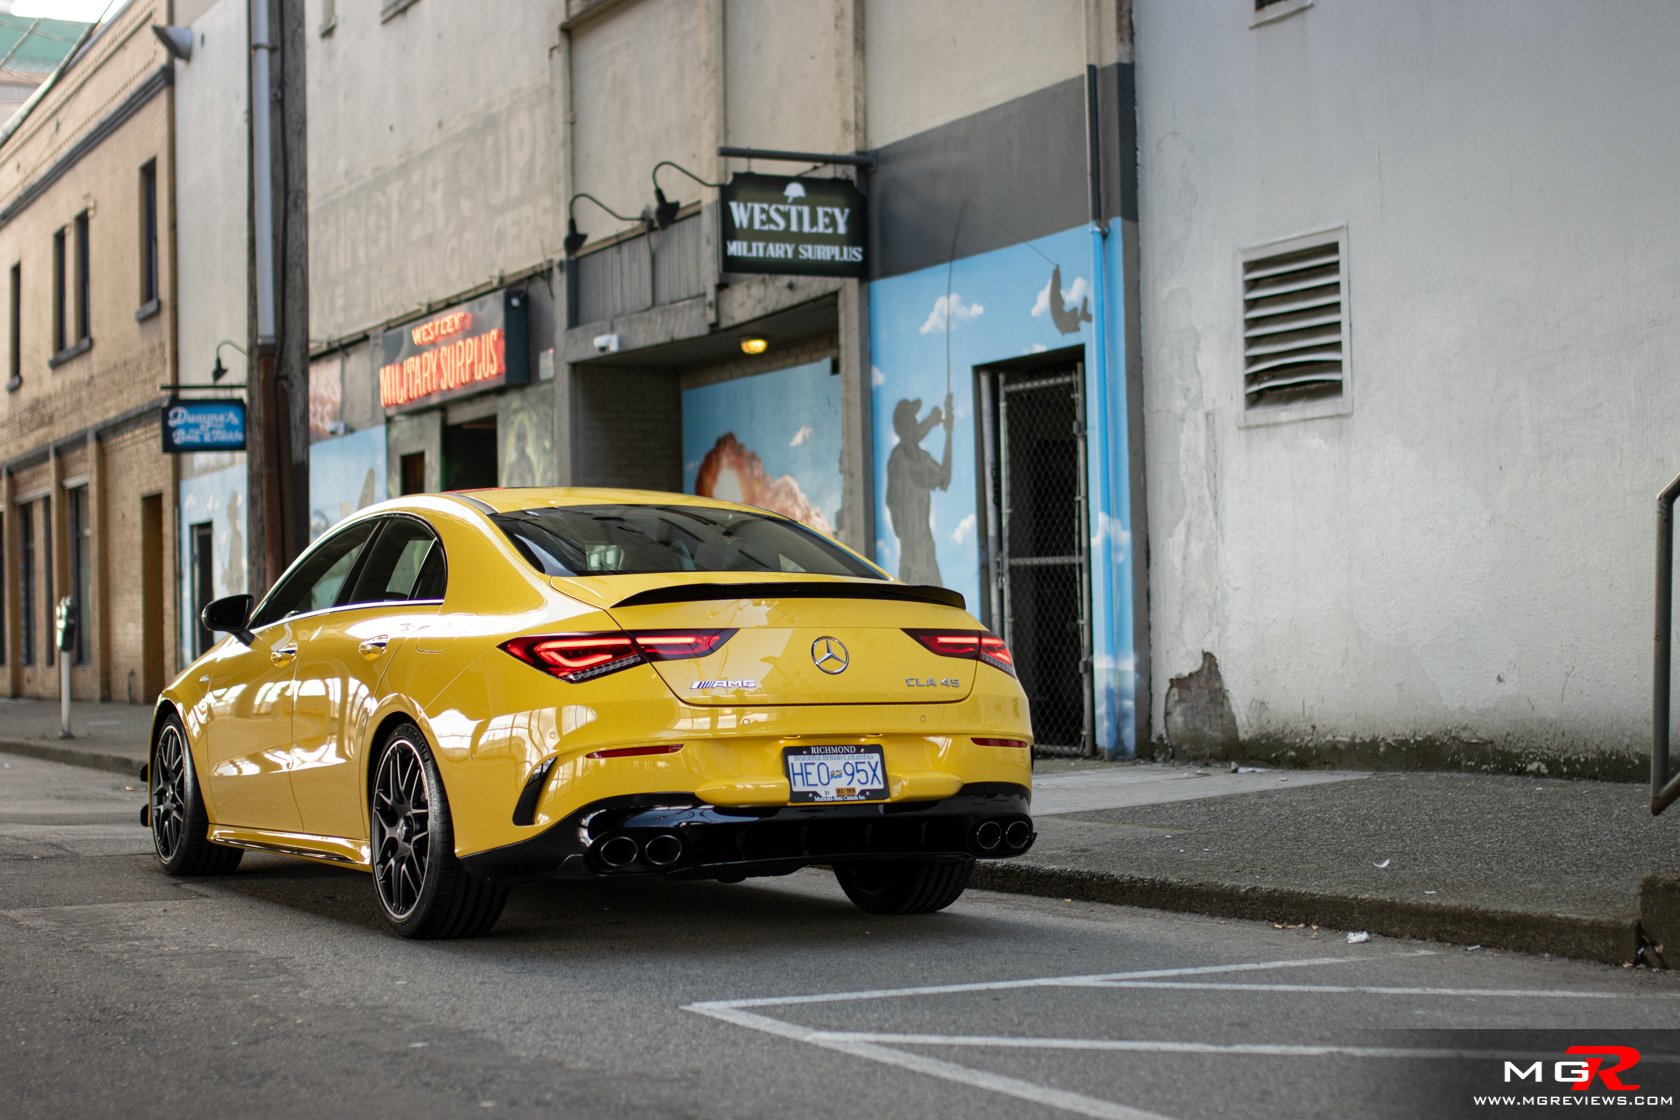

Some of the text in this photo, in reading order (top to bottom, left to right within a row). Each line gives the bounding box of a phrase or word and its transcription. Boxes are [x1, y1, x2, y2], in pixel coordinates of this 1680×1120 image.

[729, 201, 850, 235] WESTLEY
[726, 240, 863, 262] MILITARY SURPLUS
[411, 311, 467, 345] WESTLEY
[380, 349, 438, 408] MILITARY
[440, 328, 500, 390] SURPLUS
[712, 680, 757, 688] AMG
[906, 677, 960, 688] CLA 45
[811, 745, 856, 754] RICHMOND
[823, 753, 843, 761] British
[843, 753, 874, 761] Columbia
[843, 761, 882, 786] 95X
